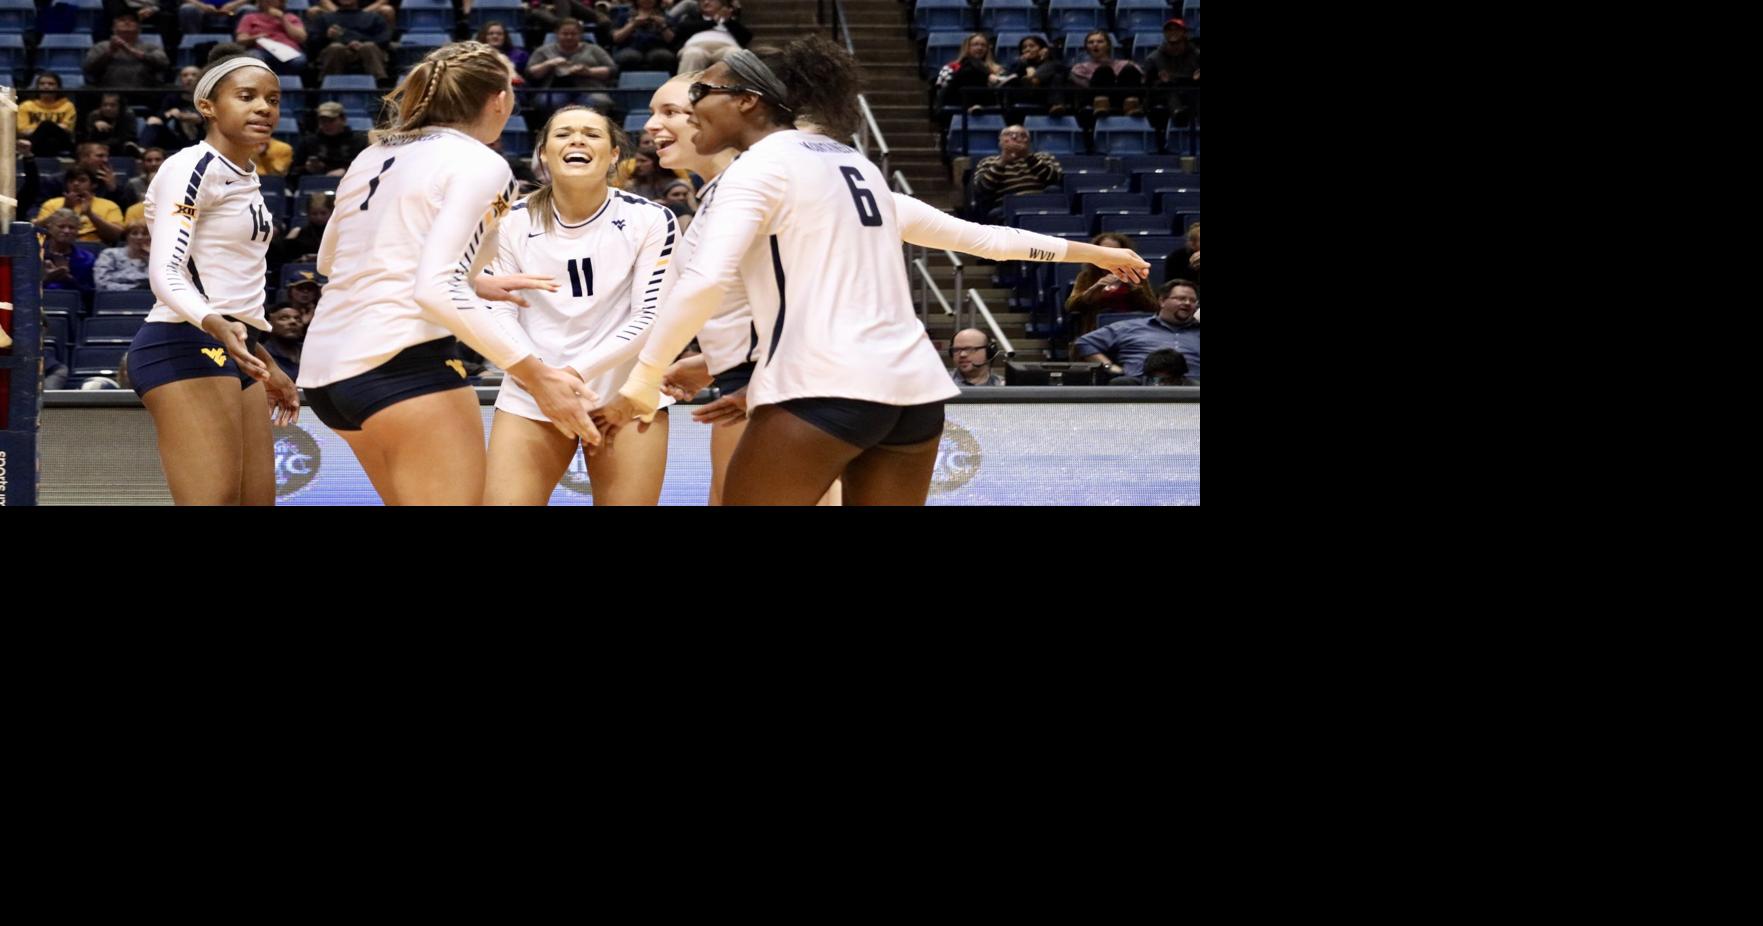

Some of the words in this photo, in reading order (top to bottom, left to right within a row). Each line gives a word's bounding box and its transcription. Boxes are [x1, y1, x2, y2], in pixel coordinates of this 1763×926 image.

[359, 156, 396, 211] 1
[838, 165, 883, 227] 6
[249, 203, 271, 242] 14
[1029, 247, 1056, 261] WVU
[567, 257, 594, 297] 11
